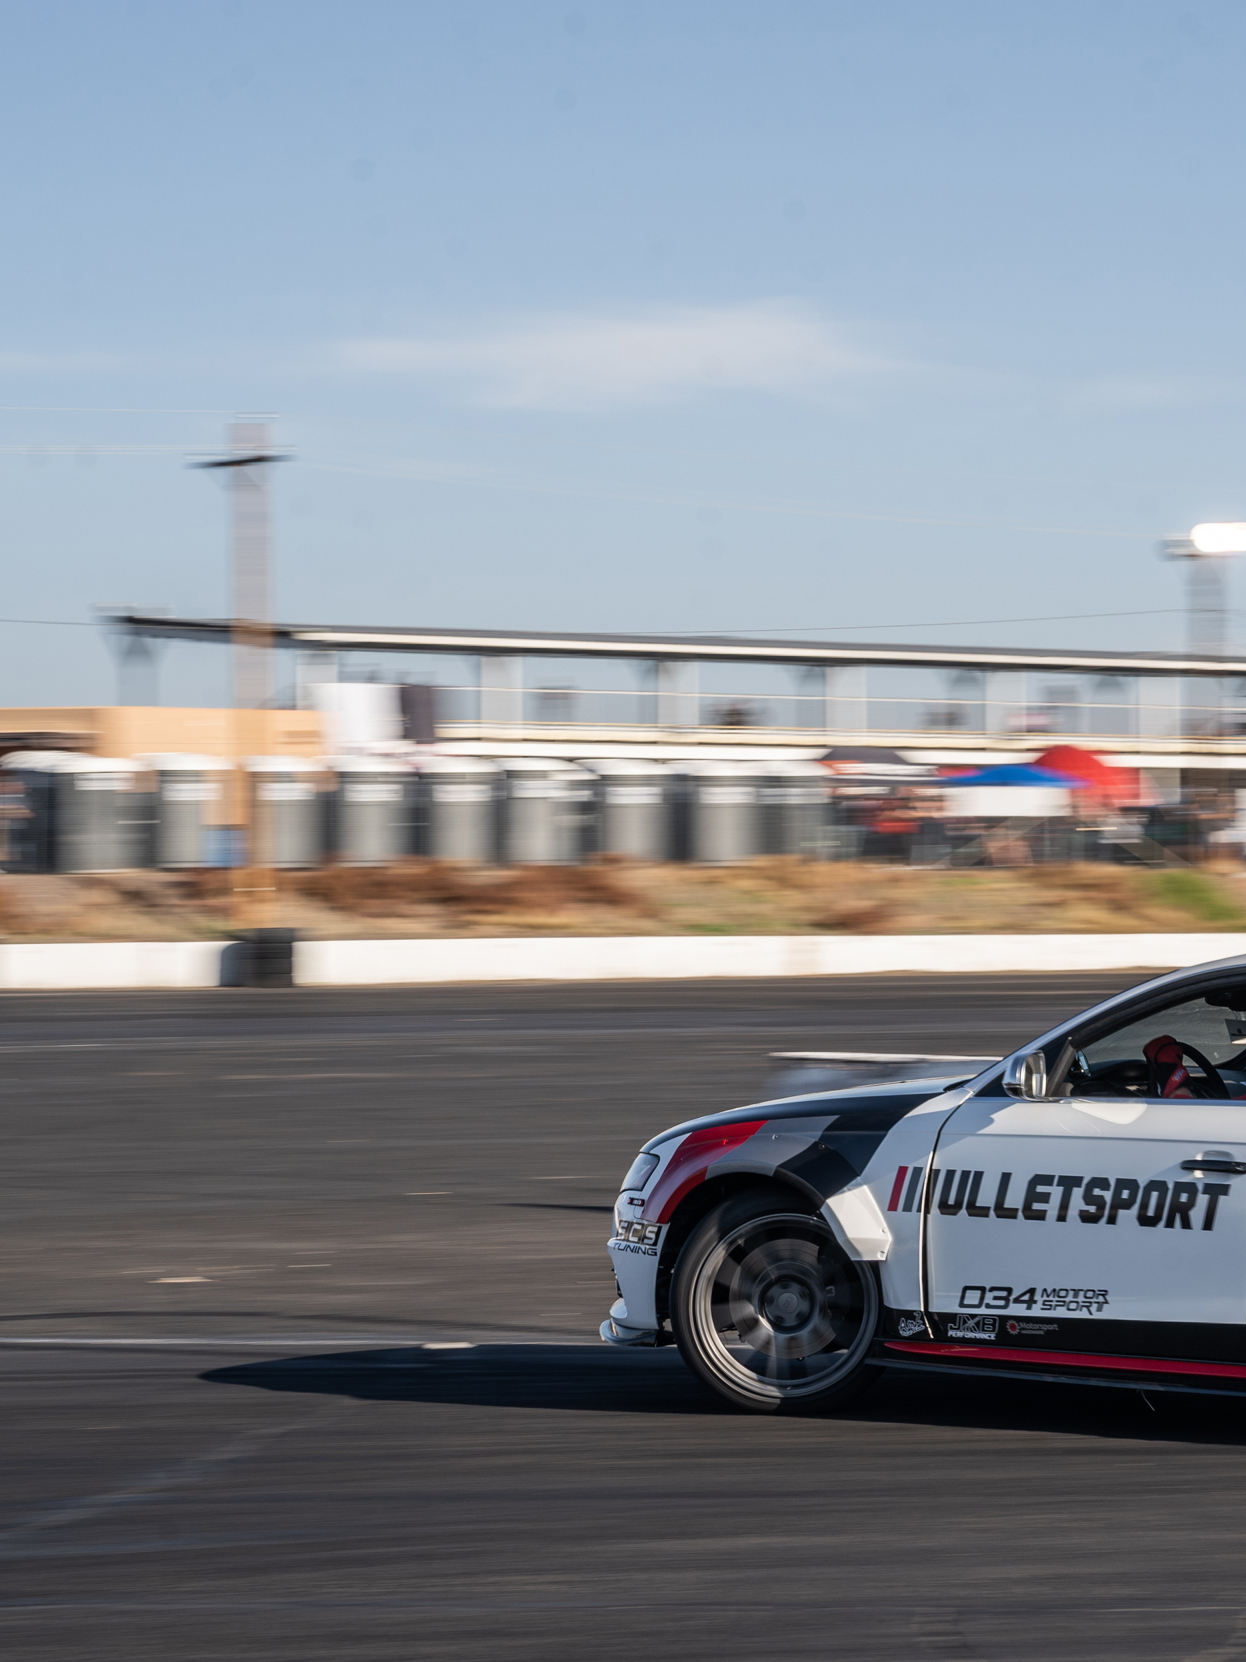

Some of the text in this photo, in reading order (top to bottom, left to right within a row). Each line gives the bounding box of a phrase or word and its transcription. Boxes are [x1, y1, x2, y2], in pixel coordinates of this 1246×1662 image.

[617, 1221, 659, 1245] ECS
[613, 1242, 658, 1257] TUNING
[958, 1285, 1038, 1311] 034
[1040, 1287, 1110, 1304] MOTOR
[1040, 1300, 1104, 1315] SPORT
[947, 1314, 999, 1334] JXB
